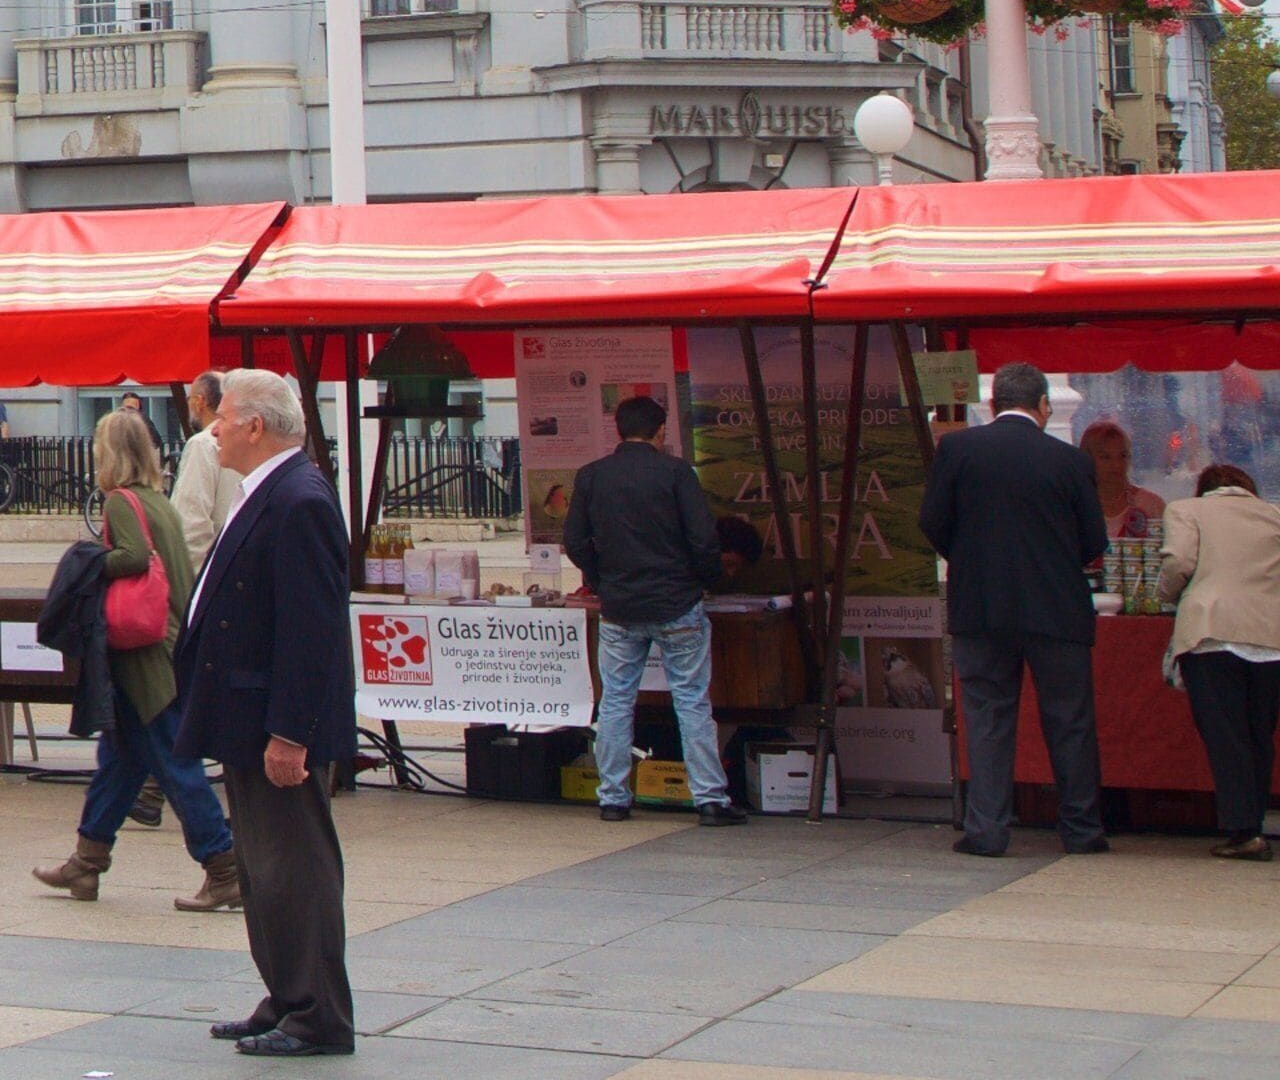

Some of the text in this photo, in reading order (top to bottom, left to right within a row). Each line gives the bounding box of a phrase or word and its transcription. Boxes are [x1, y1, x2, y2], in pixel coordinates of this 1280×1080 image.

[818, 407, 900, 425] PRIODE
[864, 605, 932, 621] zahvaljuju!
[438, 617, 579, 647] Glas životinja
[441, 647, 580, 661] Udruga za širenje svijesti
[367, 668, 431, 682] GLAS ŽIVOTINJA
[455, 661, 567, 674] o jedinstvu čovjeka,
[462, 673, 562, 686] prirode i životinja
[378, 697, 570, 717] www.glas-zivotinja.org
